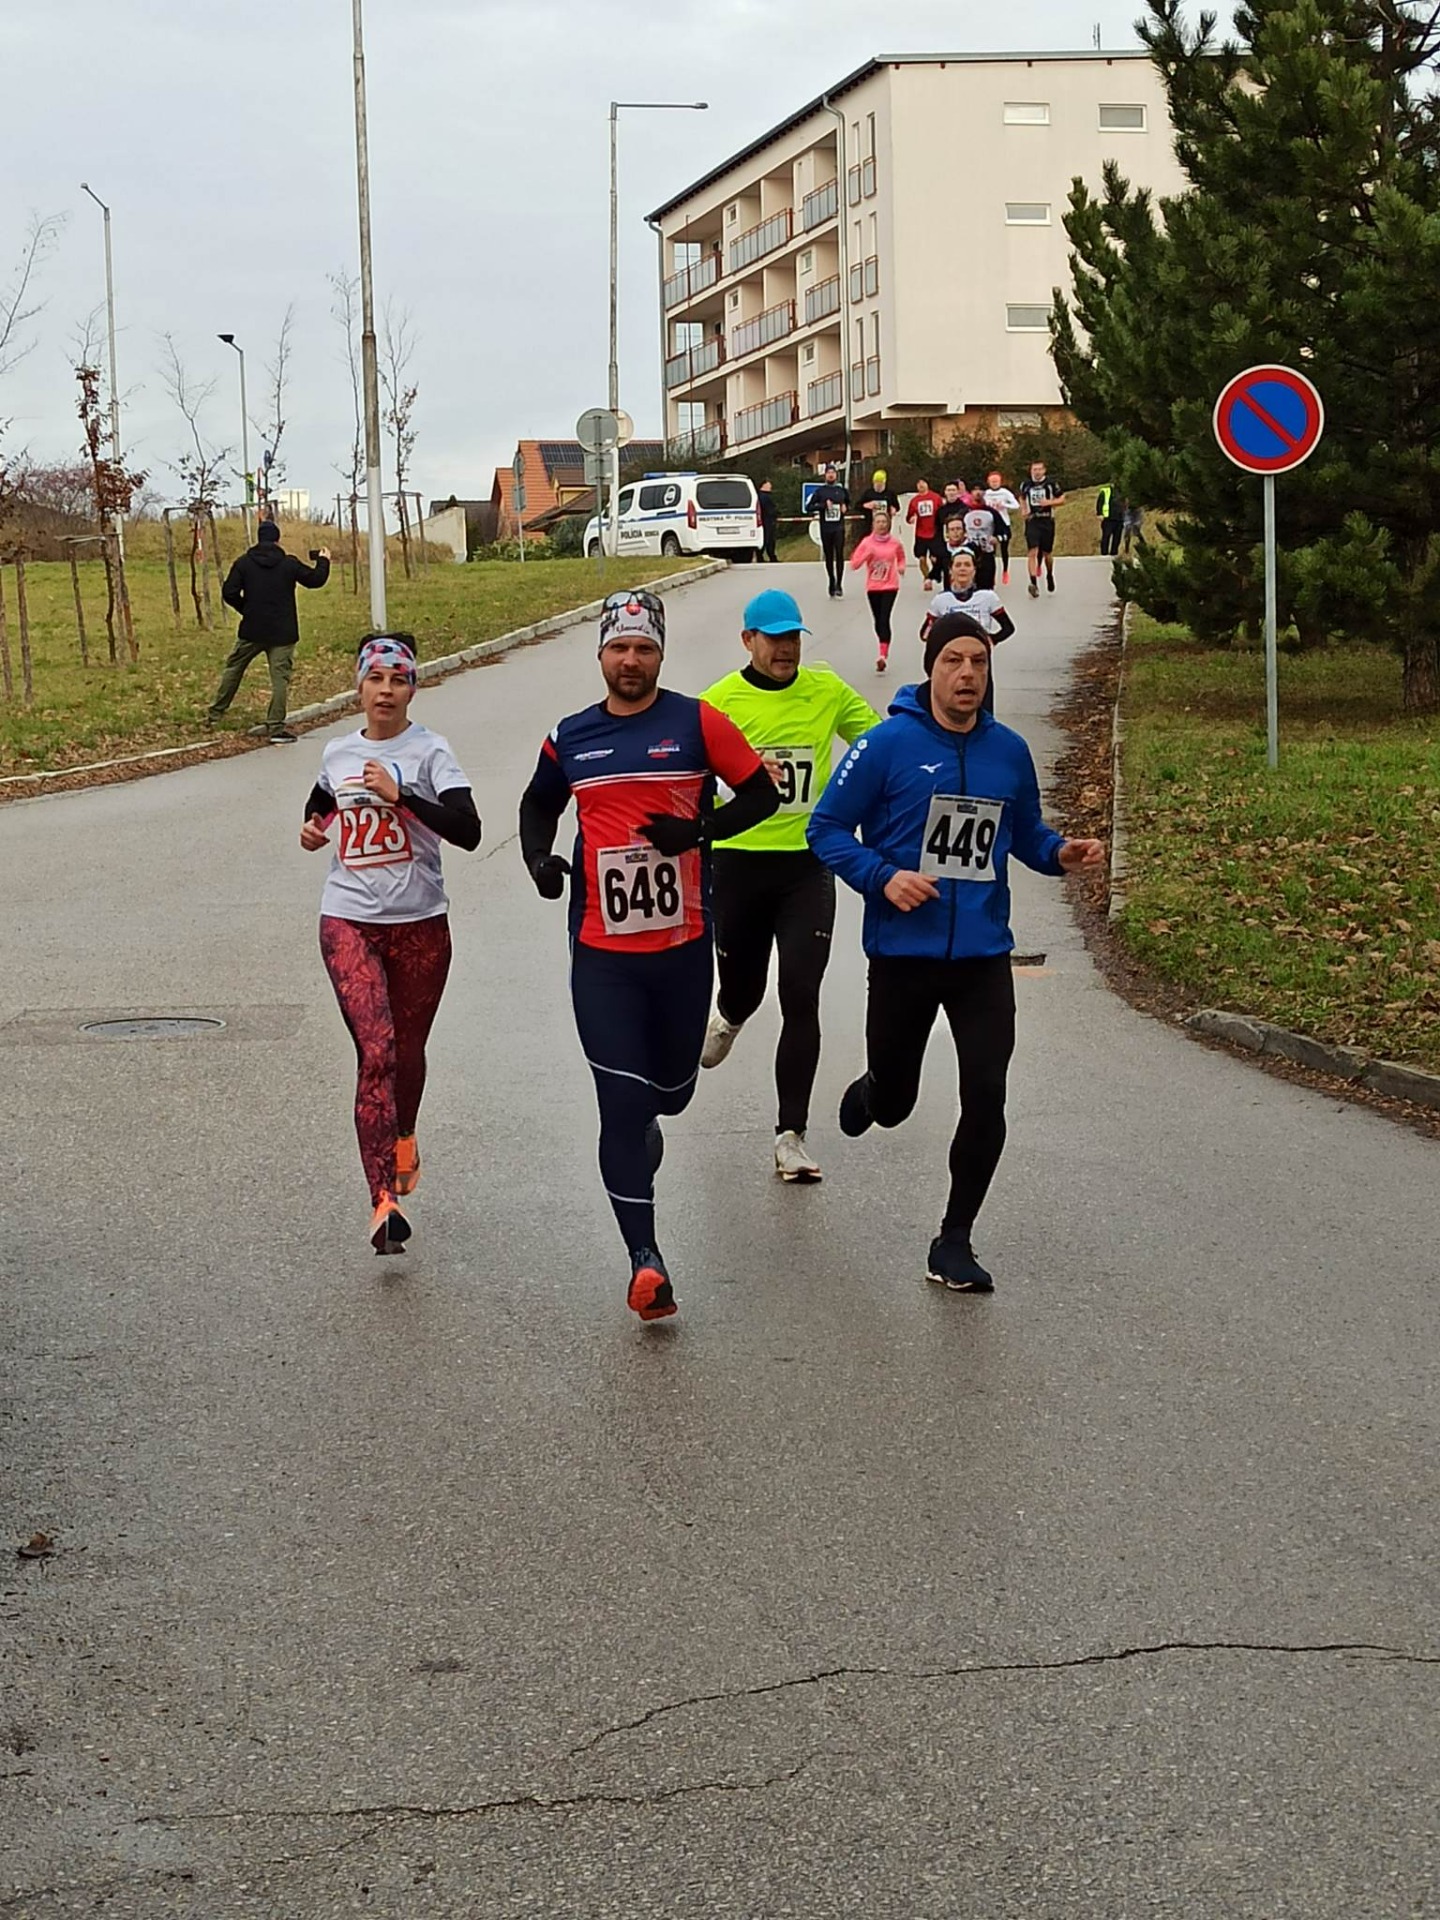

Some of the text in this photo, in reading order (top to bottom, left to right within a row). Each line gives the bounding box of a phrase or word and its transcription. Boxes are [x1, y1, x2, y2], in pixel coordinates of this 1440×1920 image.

[620, 528, 643, 540] POLÍCIA
[778, 760, 813, 805] 97
[342, 807, 406, 857] 223
[926, 814, 996, 870] 449
[604, 862, 680, 923] 648
